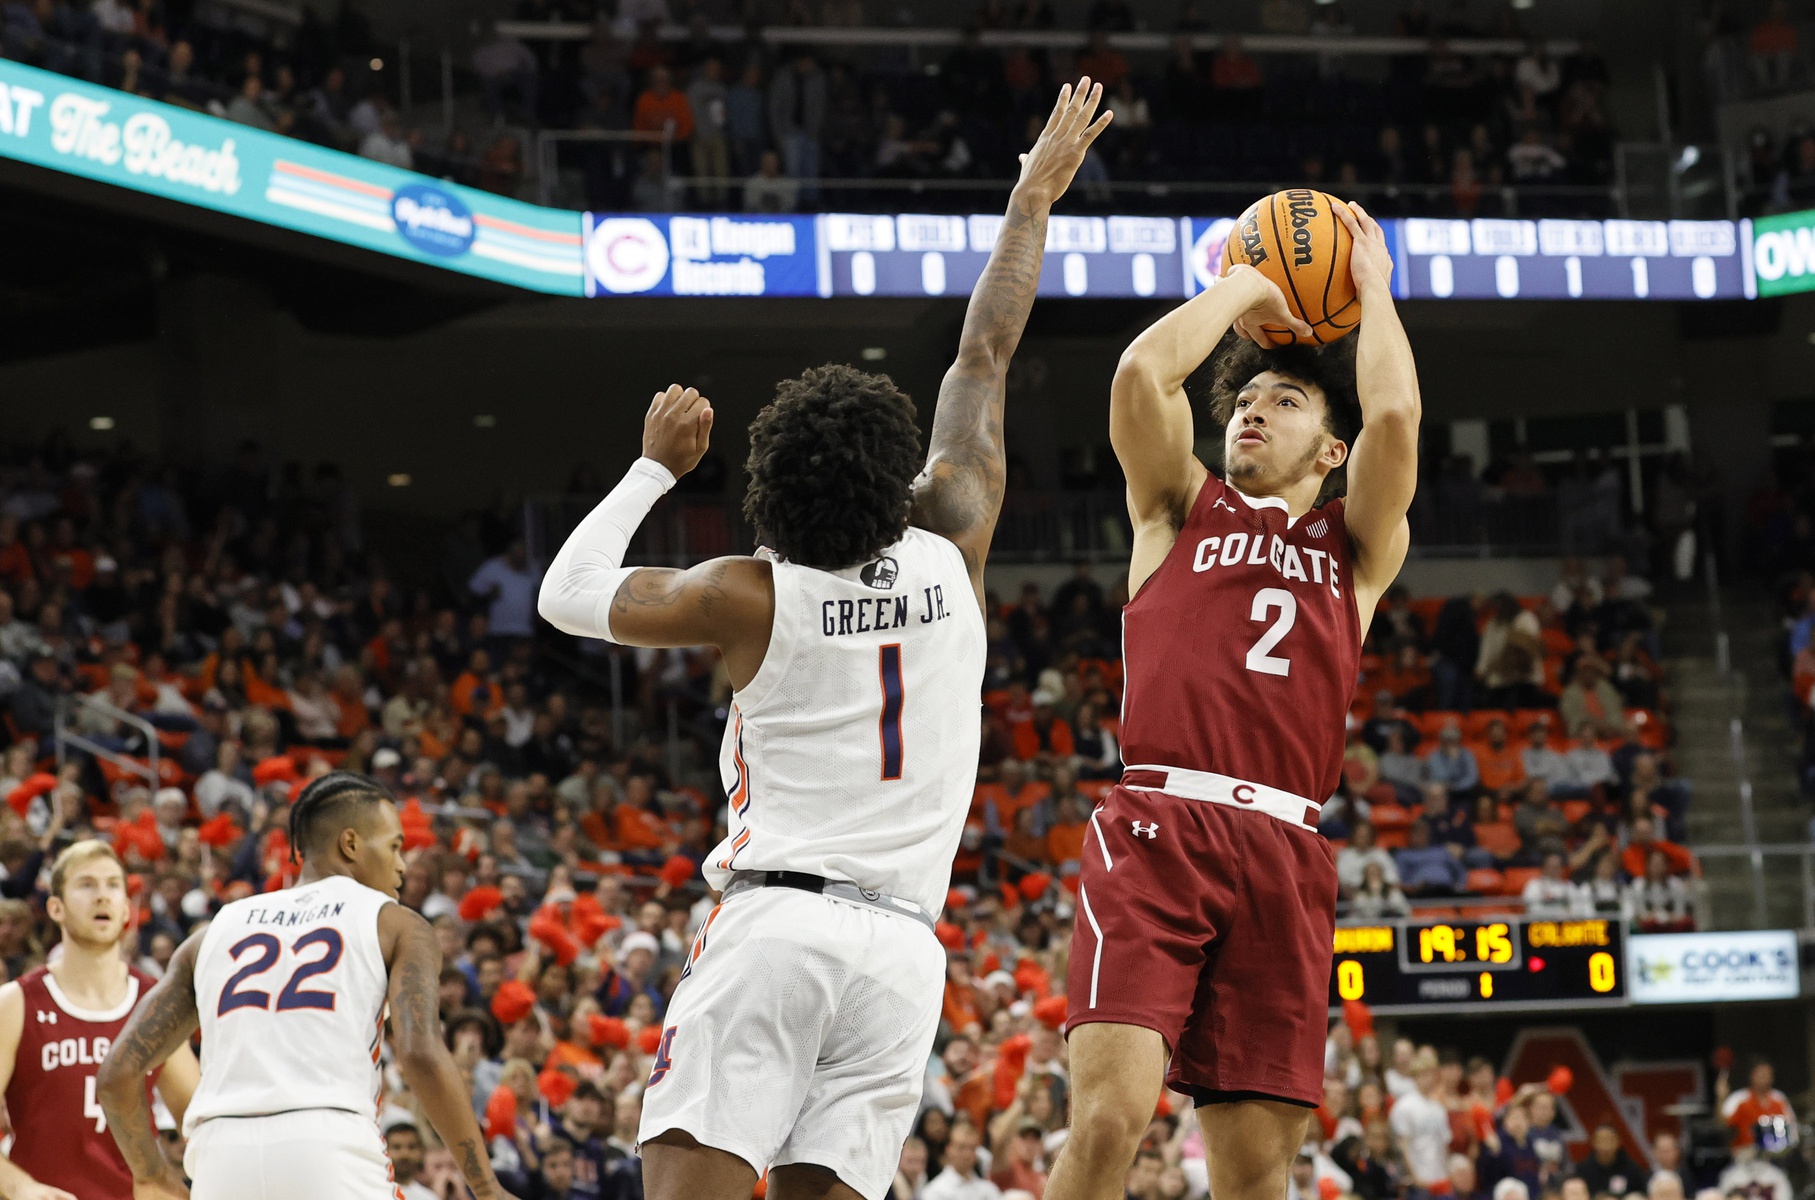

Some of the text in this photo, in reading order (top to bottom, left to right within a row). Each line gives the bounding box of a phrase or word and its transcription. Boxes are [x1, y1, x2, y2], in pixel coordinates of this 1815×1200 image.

[50, 92, 121, 165] The
[122, 112, 242, 195] Beach
[1286, 188, 1318, 267] Wilson
[1192, 532, 1341, 599] COLGATE
[822, 584, 951, 637] GREEN JR.
[1246, 588, 1297, 677] 2
[879, 643, 905, 782] 1
[246, 902, 345, 927] FLANIGAN
[1419, 923, 1513, 964] 19:15
[217, 927, 344, 1019] 22
[1337, 960, 1364, 1000] 0
[1588, 952, 1615, 993] 0
[41, 1036, 111, 1072] COLG
